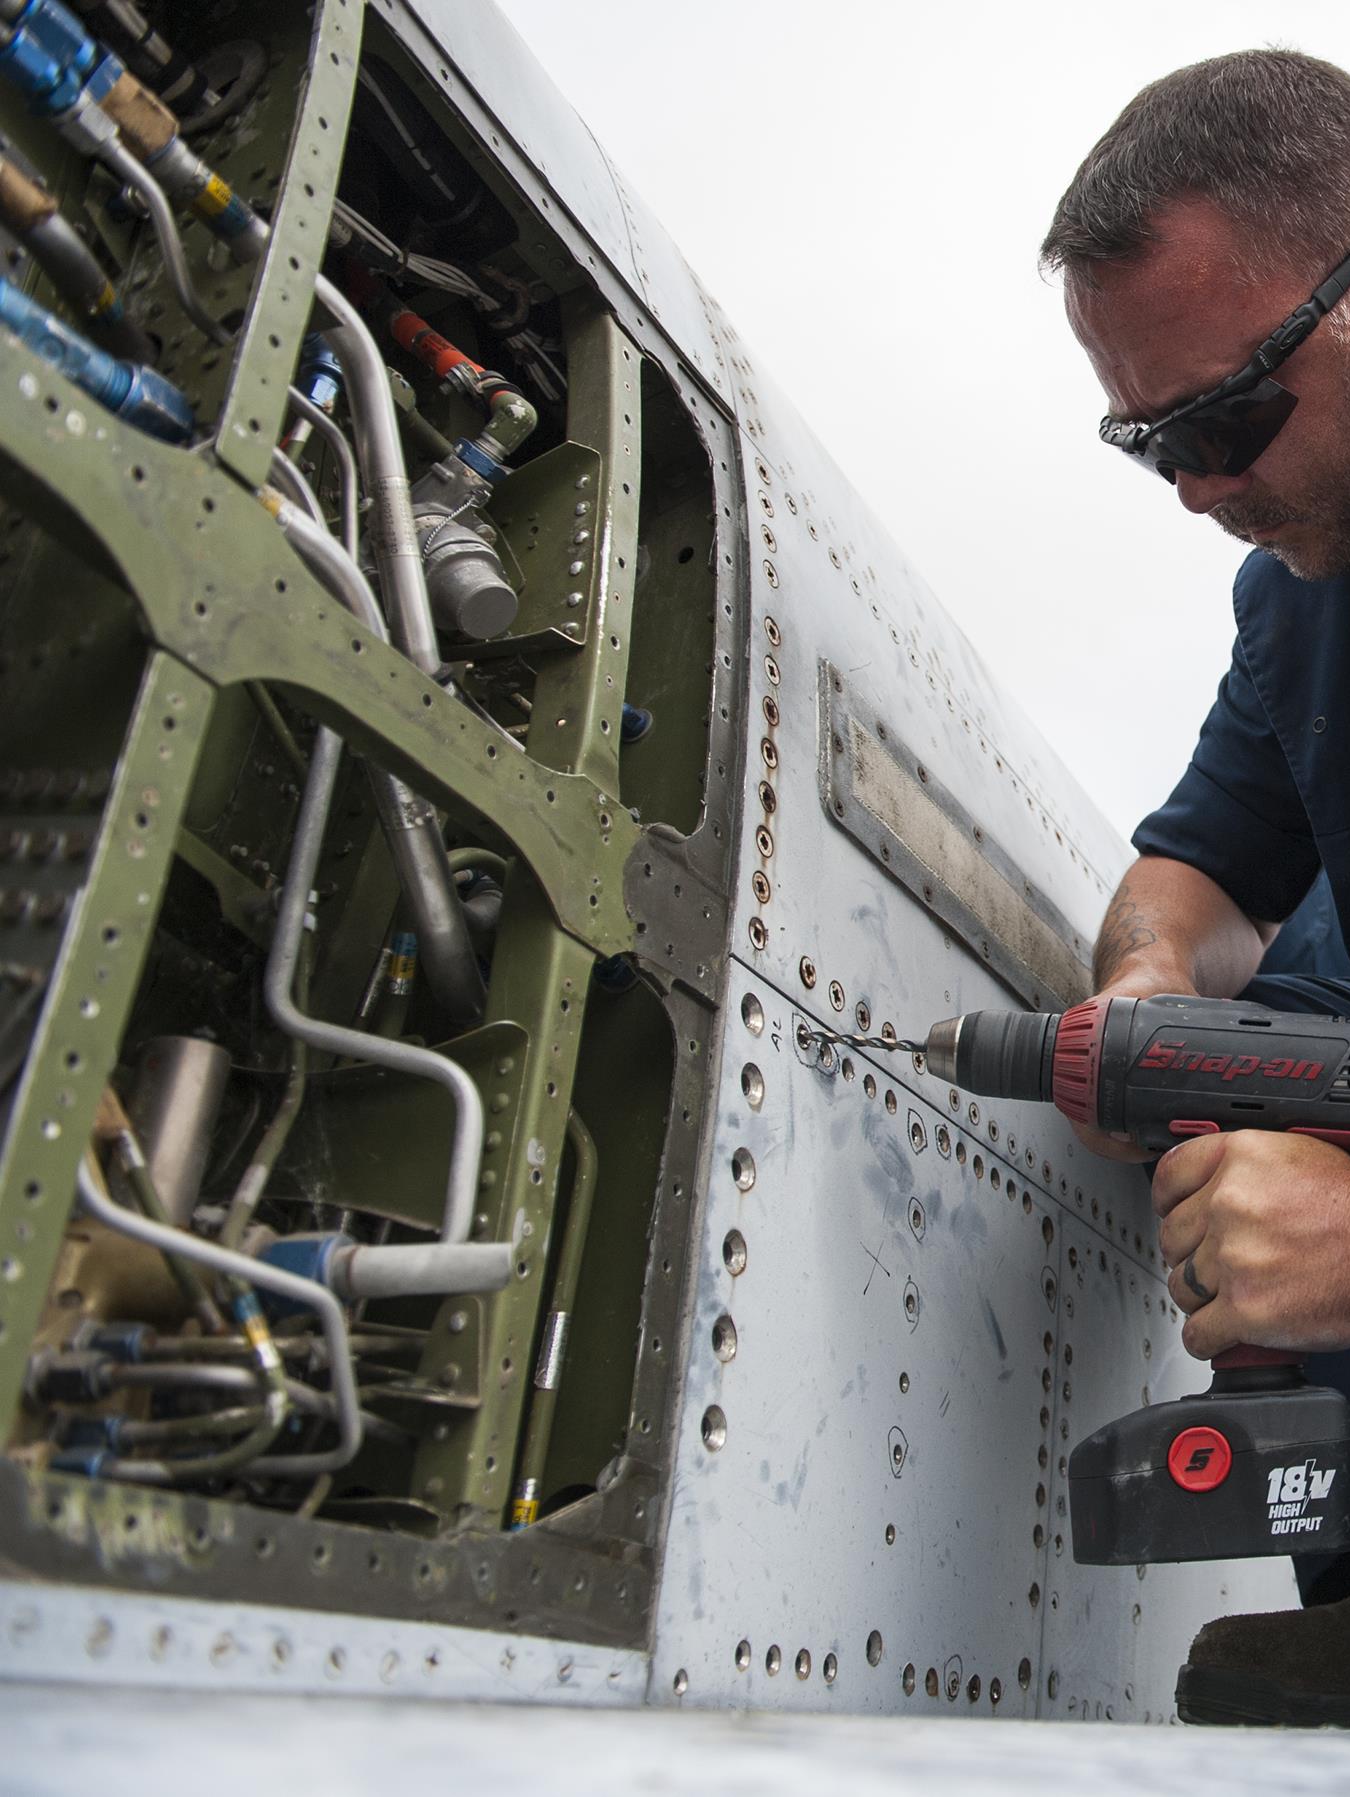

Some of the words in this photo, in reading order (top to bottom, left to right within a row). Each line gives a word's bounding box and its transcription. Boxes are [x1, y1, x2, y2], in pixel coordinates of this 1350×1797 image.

[1137, 1039, 1325, 1080] Snap-on
[1268, 1503, 1301, 1519] HIGH
[1271, 1516, 1323, 1535] OUTPUT
